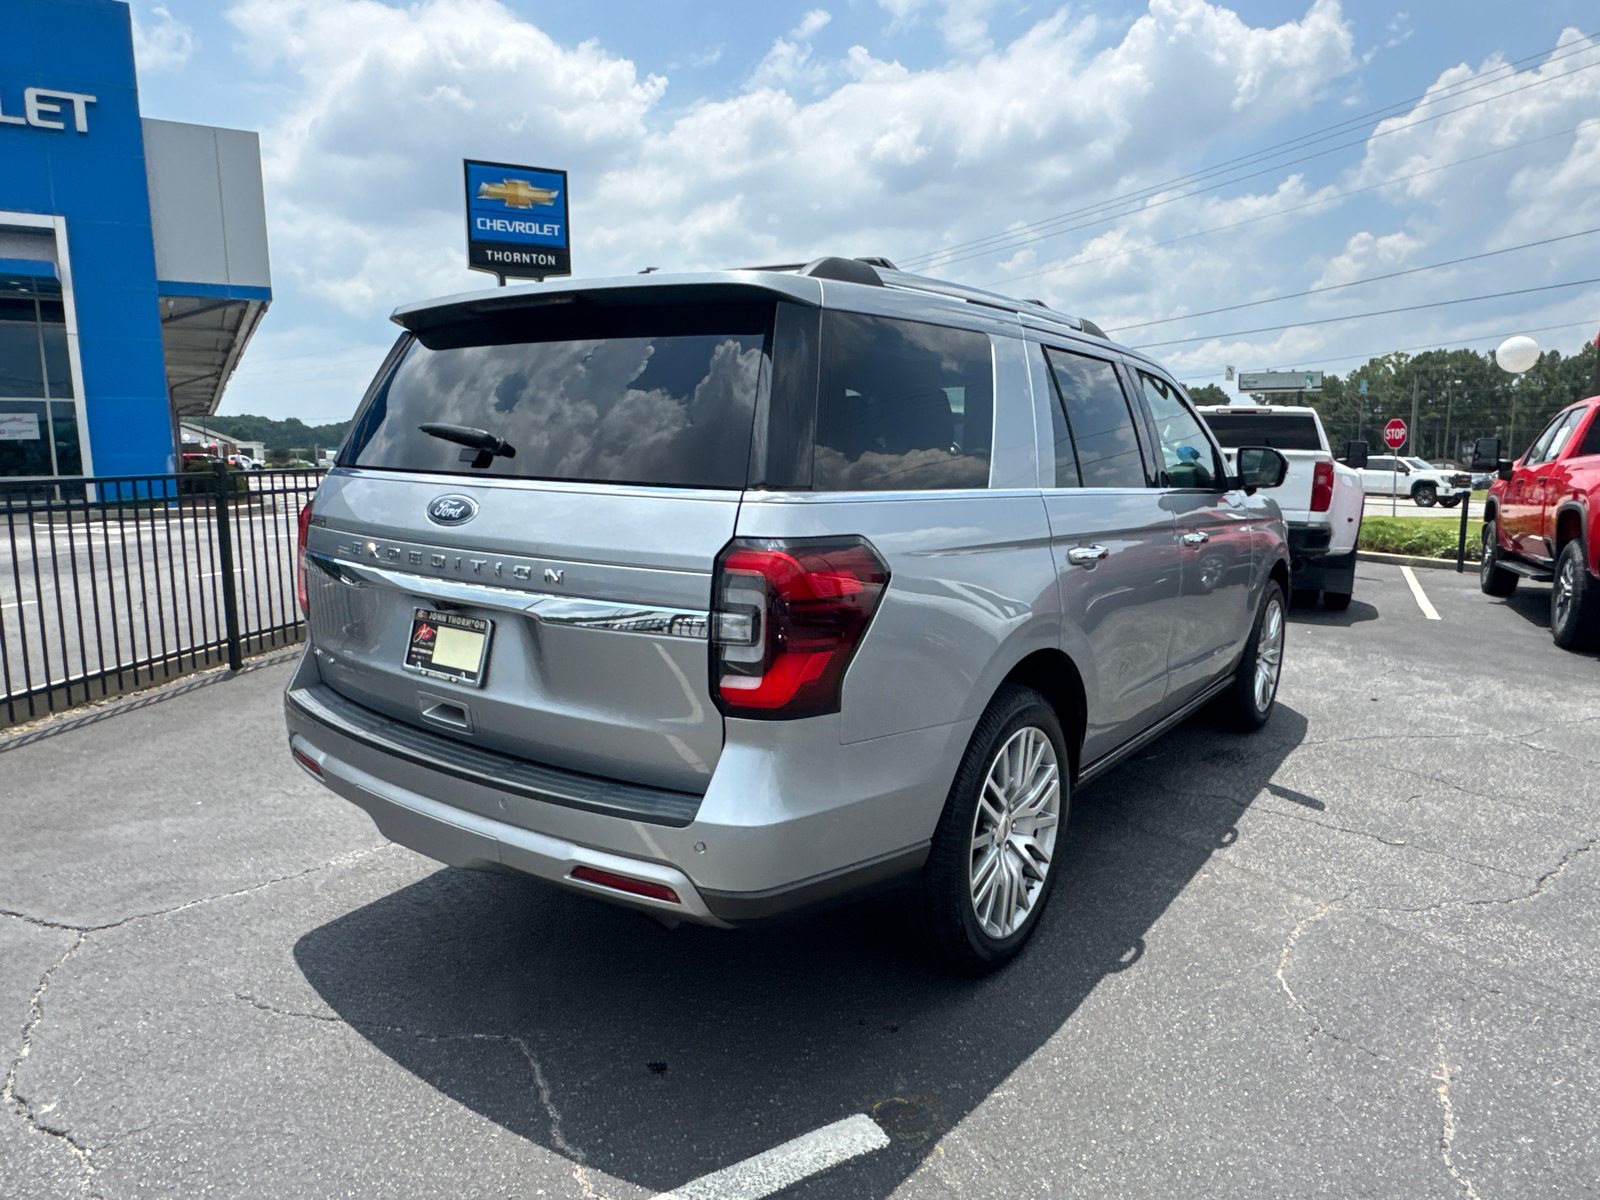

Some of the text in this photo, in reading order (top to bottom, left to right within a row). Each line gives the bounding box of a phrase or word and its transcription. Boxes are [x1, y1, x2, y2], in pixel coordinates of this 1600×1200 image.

[476, 217, 561, 236] CHEVROLET
[485, 249, 556, 265] THORNTON
[1385, 428, 1405, 440] STOP
[434, 499, 465, 518] Ford
[351, 541, 565, 585] EXPEDITION
[428, 612, 447, 622] JOHN
